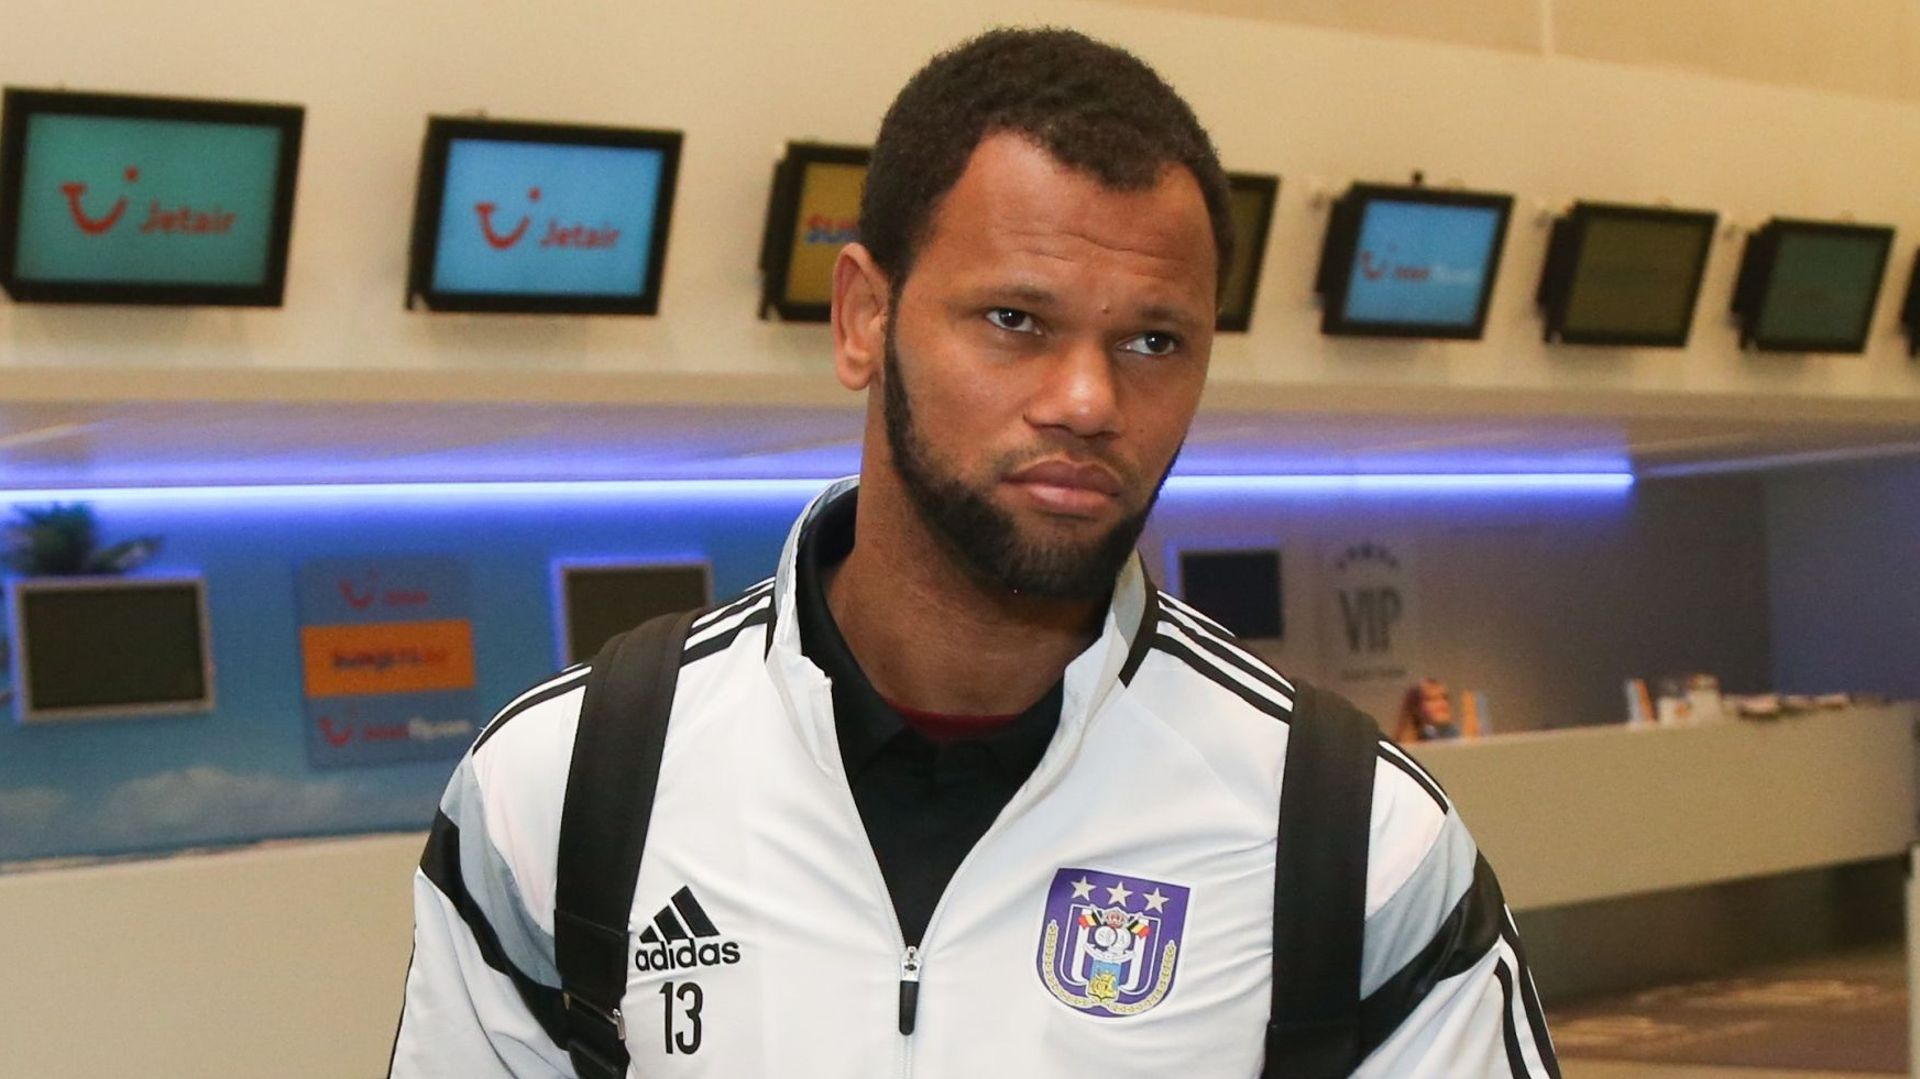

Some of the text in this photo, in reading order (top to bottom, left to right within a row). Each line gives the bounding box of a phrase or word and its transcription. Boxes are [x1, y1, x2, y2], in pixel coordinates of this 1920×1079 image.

[138, 198, 237, 235] Jetair
[539, 216, 621, 249] Jetair
[1337, 586, 1404, 653] VIP
[635, 937, 741, 972] adidas
[658, 981, 704, 1056] 13
